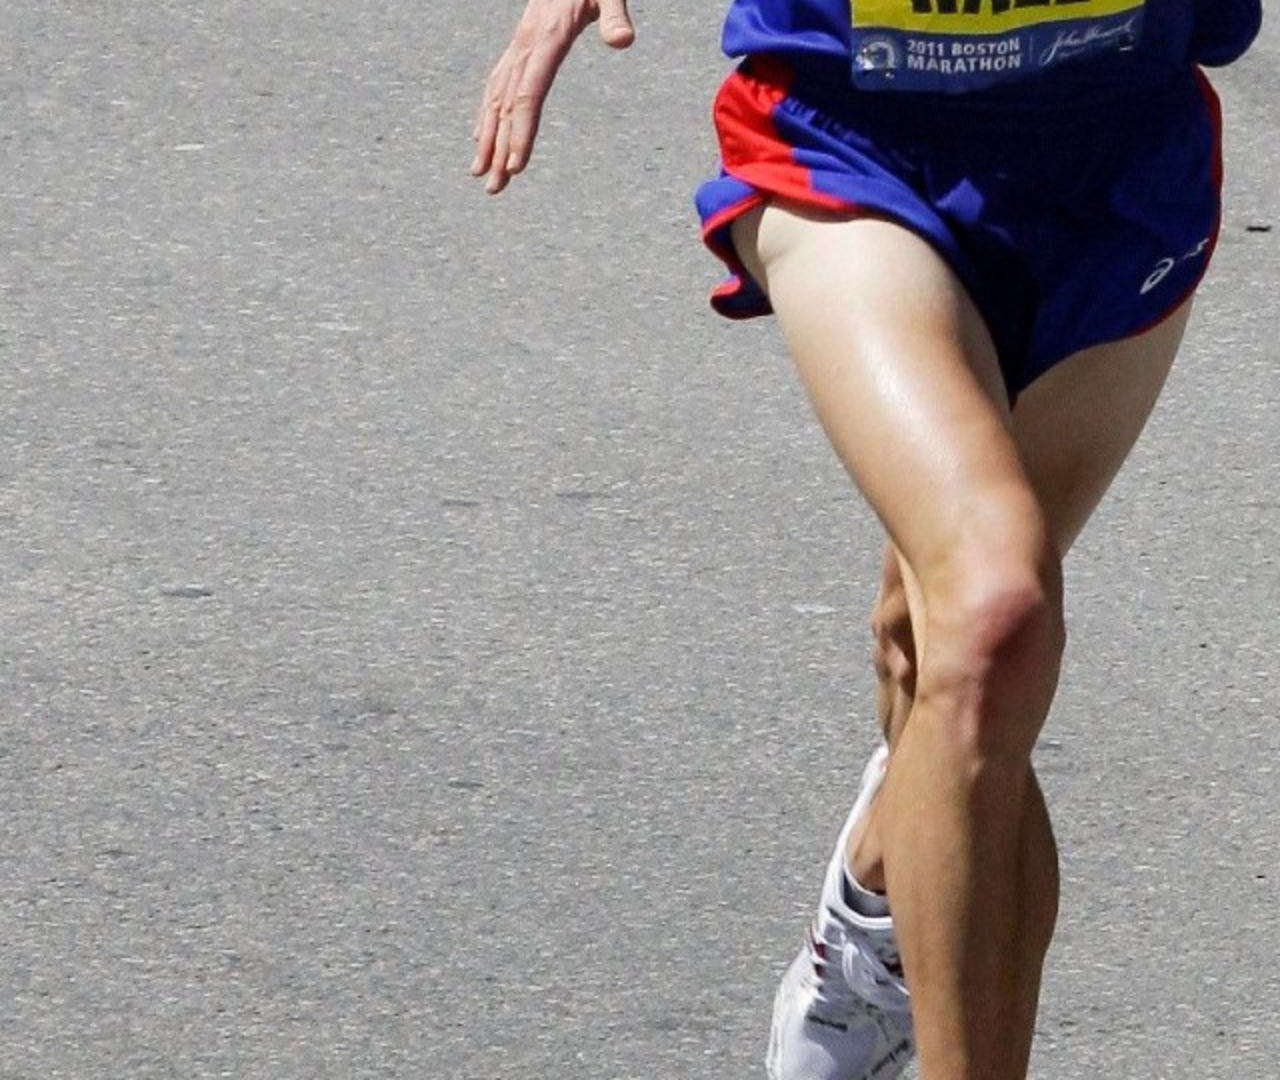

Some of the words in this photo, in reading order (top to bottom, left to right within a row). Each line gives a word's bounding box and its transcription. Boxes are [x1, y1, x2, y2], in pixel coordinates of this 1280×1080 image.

[907, 39, 945, 56] 2011
[951, 37, 1020, 57] BOSTON
[907, 53, 1021, 74] MARATHON
